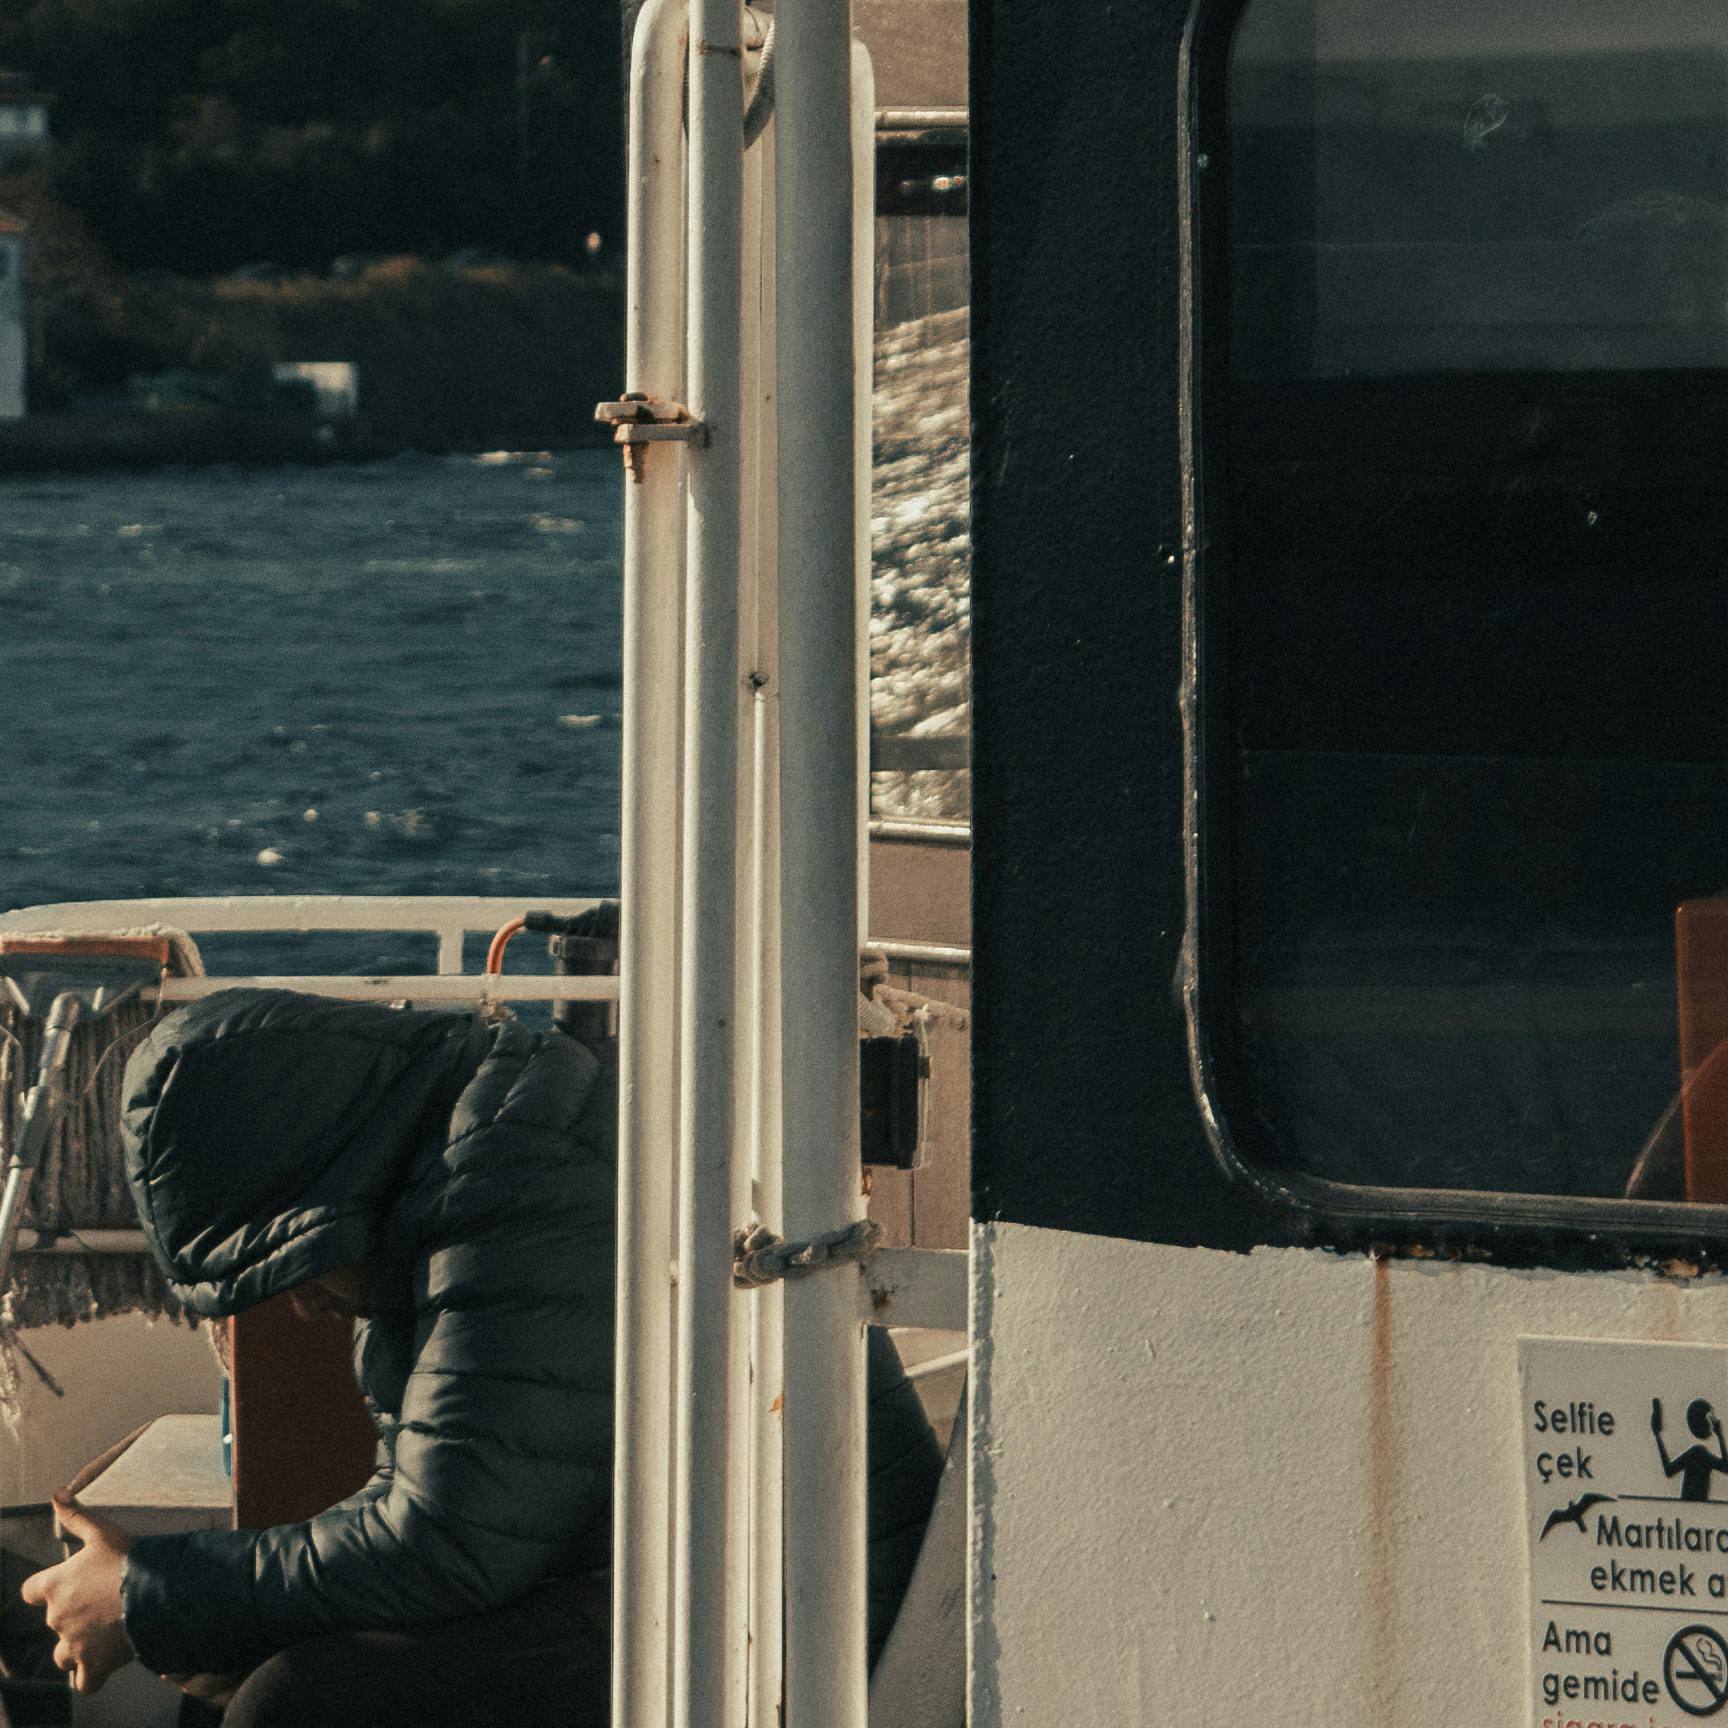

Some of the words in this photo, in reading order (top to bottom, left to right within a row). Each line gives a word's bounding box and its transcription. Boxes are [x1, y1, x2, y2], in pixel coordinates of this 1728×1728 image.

[1533, 1400, 1616, 1435] Selfie
[1536, 1446, 1594, 1483] çek
[1590, 1559, 1696, 1597] ekmek
[1542, 1620, 1612, 1655] Ama
[1542, 1668, 1660, 1706] gemide
